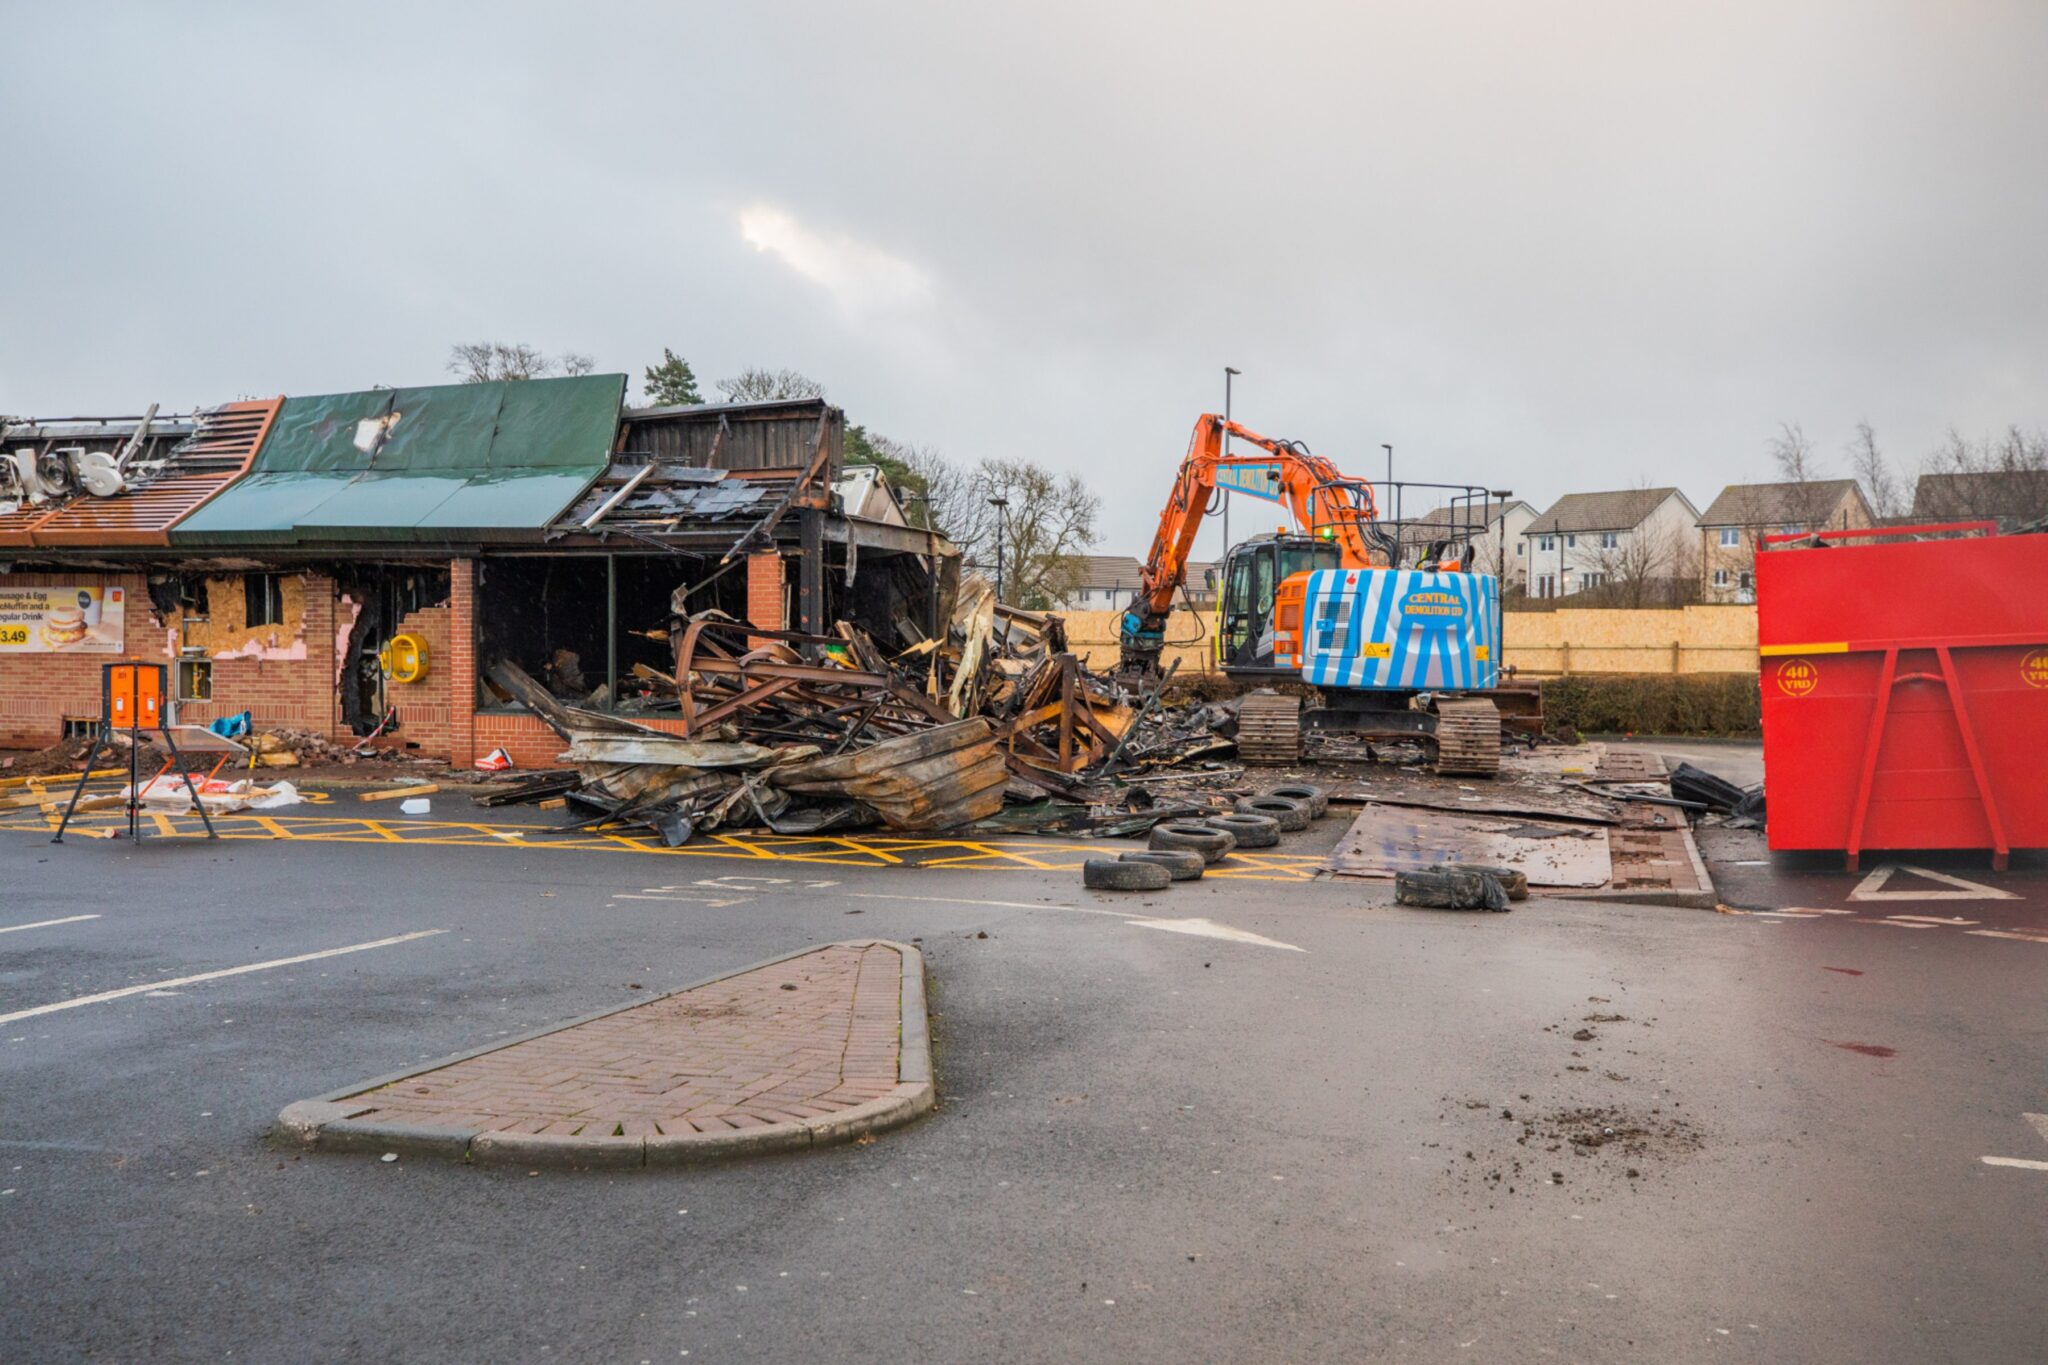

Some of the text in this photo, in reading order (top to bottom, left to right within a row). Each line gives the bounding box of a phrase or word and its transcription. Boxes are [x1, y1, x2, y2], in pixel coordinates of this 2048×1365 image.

[26, 592, 32, 600] &
[33, 592, 47, 601] Egg
[1408, 593, 1460, 604] CENTRAL
[30, 602, 44, 610] and
[1405, 606, 1462, 616] DEMOLITION LTD
[22, 612, 43, 621] Drink
[1786, 666, 1808, 678] 40
[1785, 680, 1811, 689] YRD
